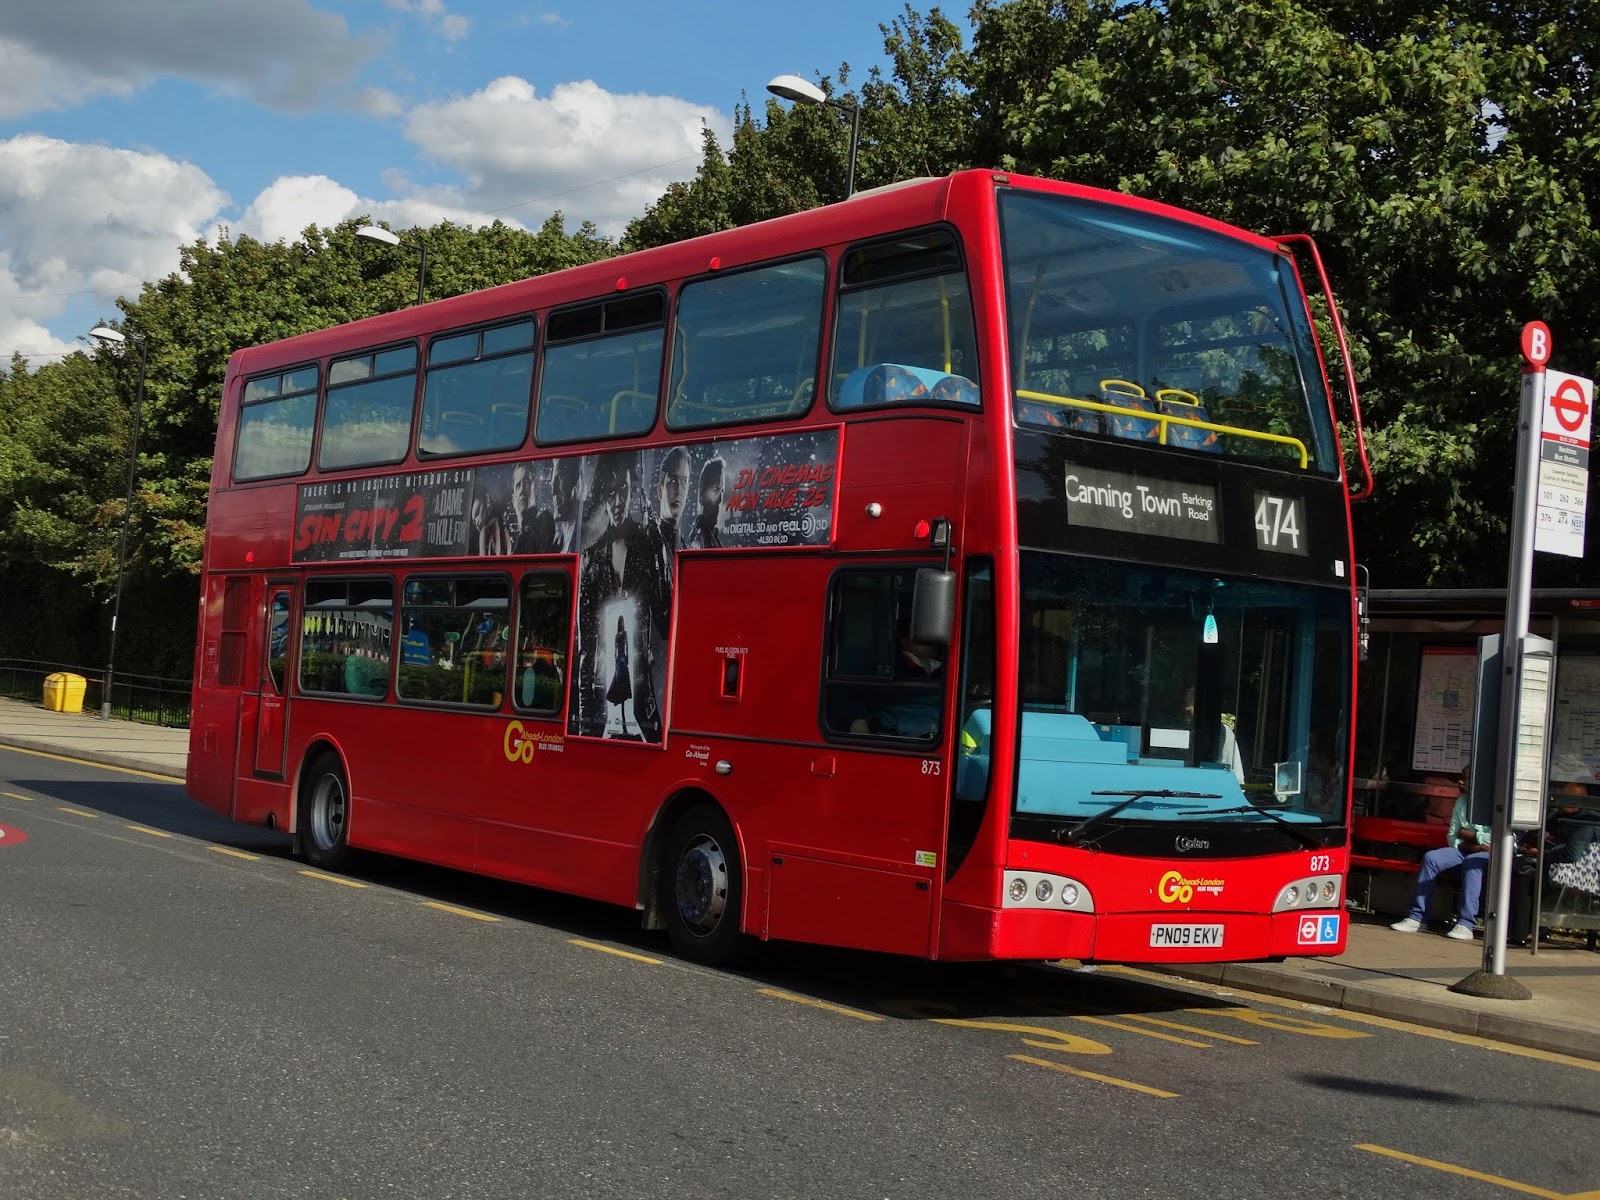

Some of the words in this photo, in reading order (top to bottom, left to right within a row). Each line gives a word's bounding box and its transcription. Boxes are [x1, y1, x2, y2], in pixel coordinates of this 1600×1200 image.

[1531, 328, 1546, 360] B
[1554, 452, 1564, 461] Bus
[1563, 454, 1580, 465] Station
[303, 485, 328, 498] THERE
[332, 483, 342, 495] IS
[346, 481, 357, 493] NO
[361, 477, 400, 492] JUSTICE
[405, 472, 448, 488] WITHOUT
[454, 470, 472, 483] SIN
[733, 468, 757, 490] IN
[758, 462, 836, 487] CINEMAS
[434, 494, 440, 514] A
[440, 488, 465, 517] DAME
[725, 492, 762, 512] MON
[763, 488, 799, 510] AUG
[801, 487, 828, 508] 25
[1064, 475, 1132, 519] Canning
[1136, 485, 1182, 518] Town
[1182, 492, 1213, 511] Barking
[1543, 490, 1553, 500] 101
[1559, 493, 1570, 503] 262
[1574, 496, 1584, 507] 366
[294, 513, 342, 552] SIN
[343, 506, 399, 542] CITY
[399, 494, 425, 542] 2
[1188, 506, 1209, 521] Road
[1254, 496, 1300, 549] 474
[1541, 512, 1552, 522] 376
[1557, 516, 1569, 525] 474
[427, 522, 436, 544] TO
[435, 518, 454, 546] KILL
[453, 520, 467, 544] FOR
[730, 522, 755, 534] DIGITAL
[756, 522, 766, 533] 3D
[816, 520, 828, 530] 3D
[759, 536, 774, 544] ALSO
[780, 535, 788, 543] 2D
[504, 720, 535, 764] Go
[685, 750, 710, 760] Go-Ahead
[921, 760, 941, 776] 873
[1310, 855, 1331, 872] 873
[1158, 870, 1193, 904] Go
[1155, 926, 1191, 945] PN09
[1193, 926, 1220, 945] EKV
